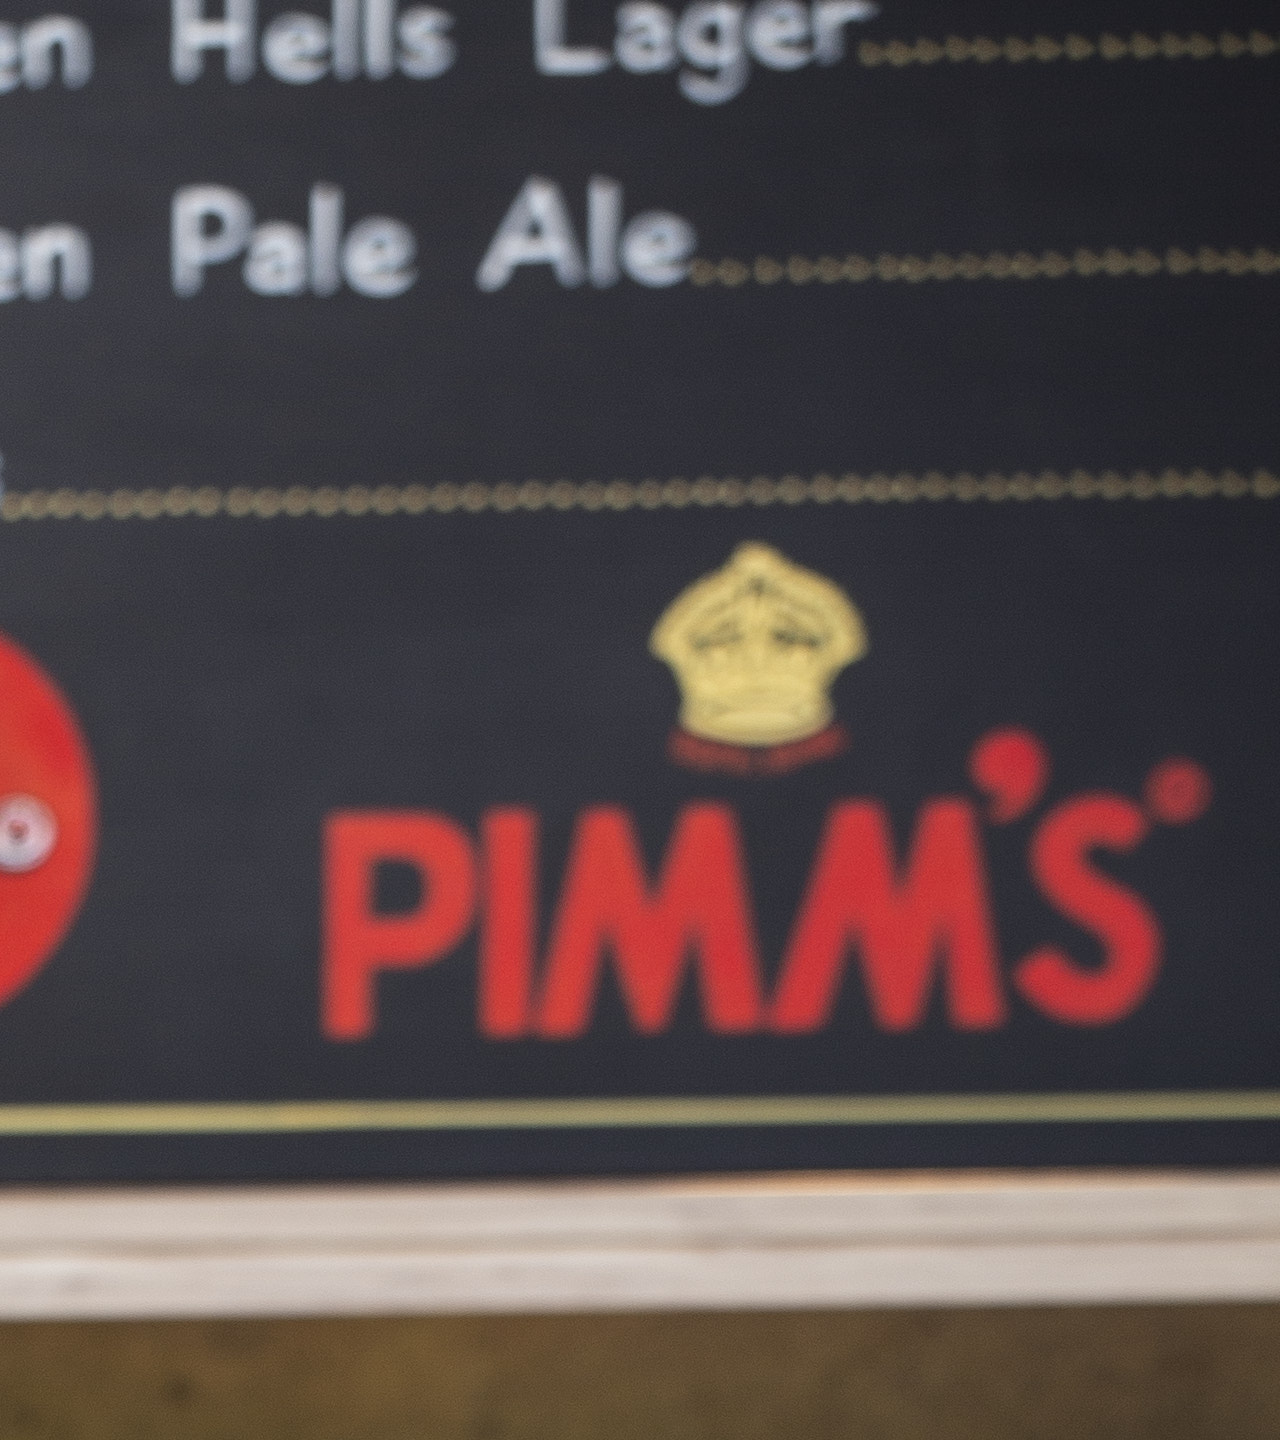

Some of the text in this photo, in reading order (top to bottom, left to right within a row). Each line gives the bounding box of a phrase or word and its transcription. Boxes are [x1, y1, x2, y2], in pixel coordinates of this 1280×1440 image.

[171, 0, 454, 84] Hells
[533, 0, 878, 106] Lager
[170, 181, 417, 298] Pale
[476, 174, 696, 292] Ale
[320, 726, 1165, 1038] PIMM'S
